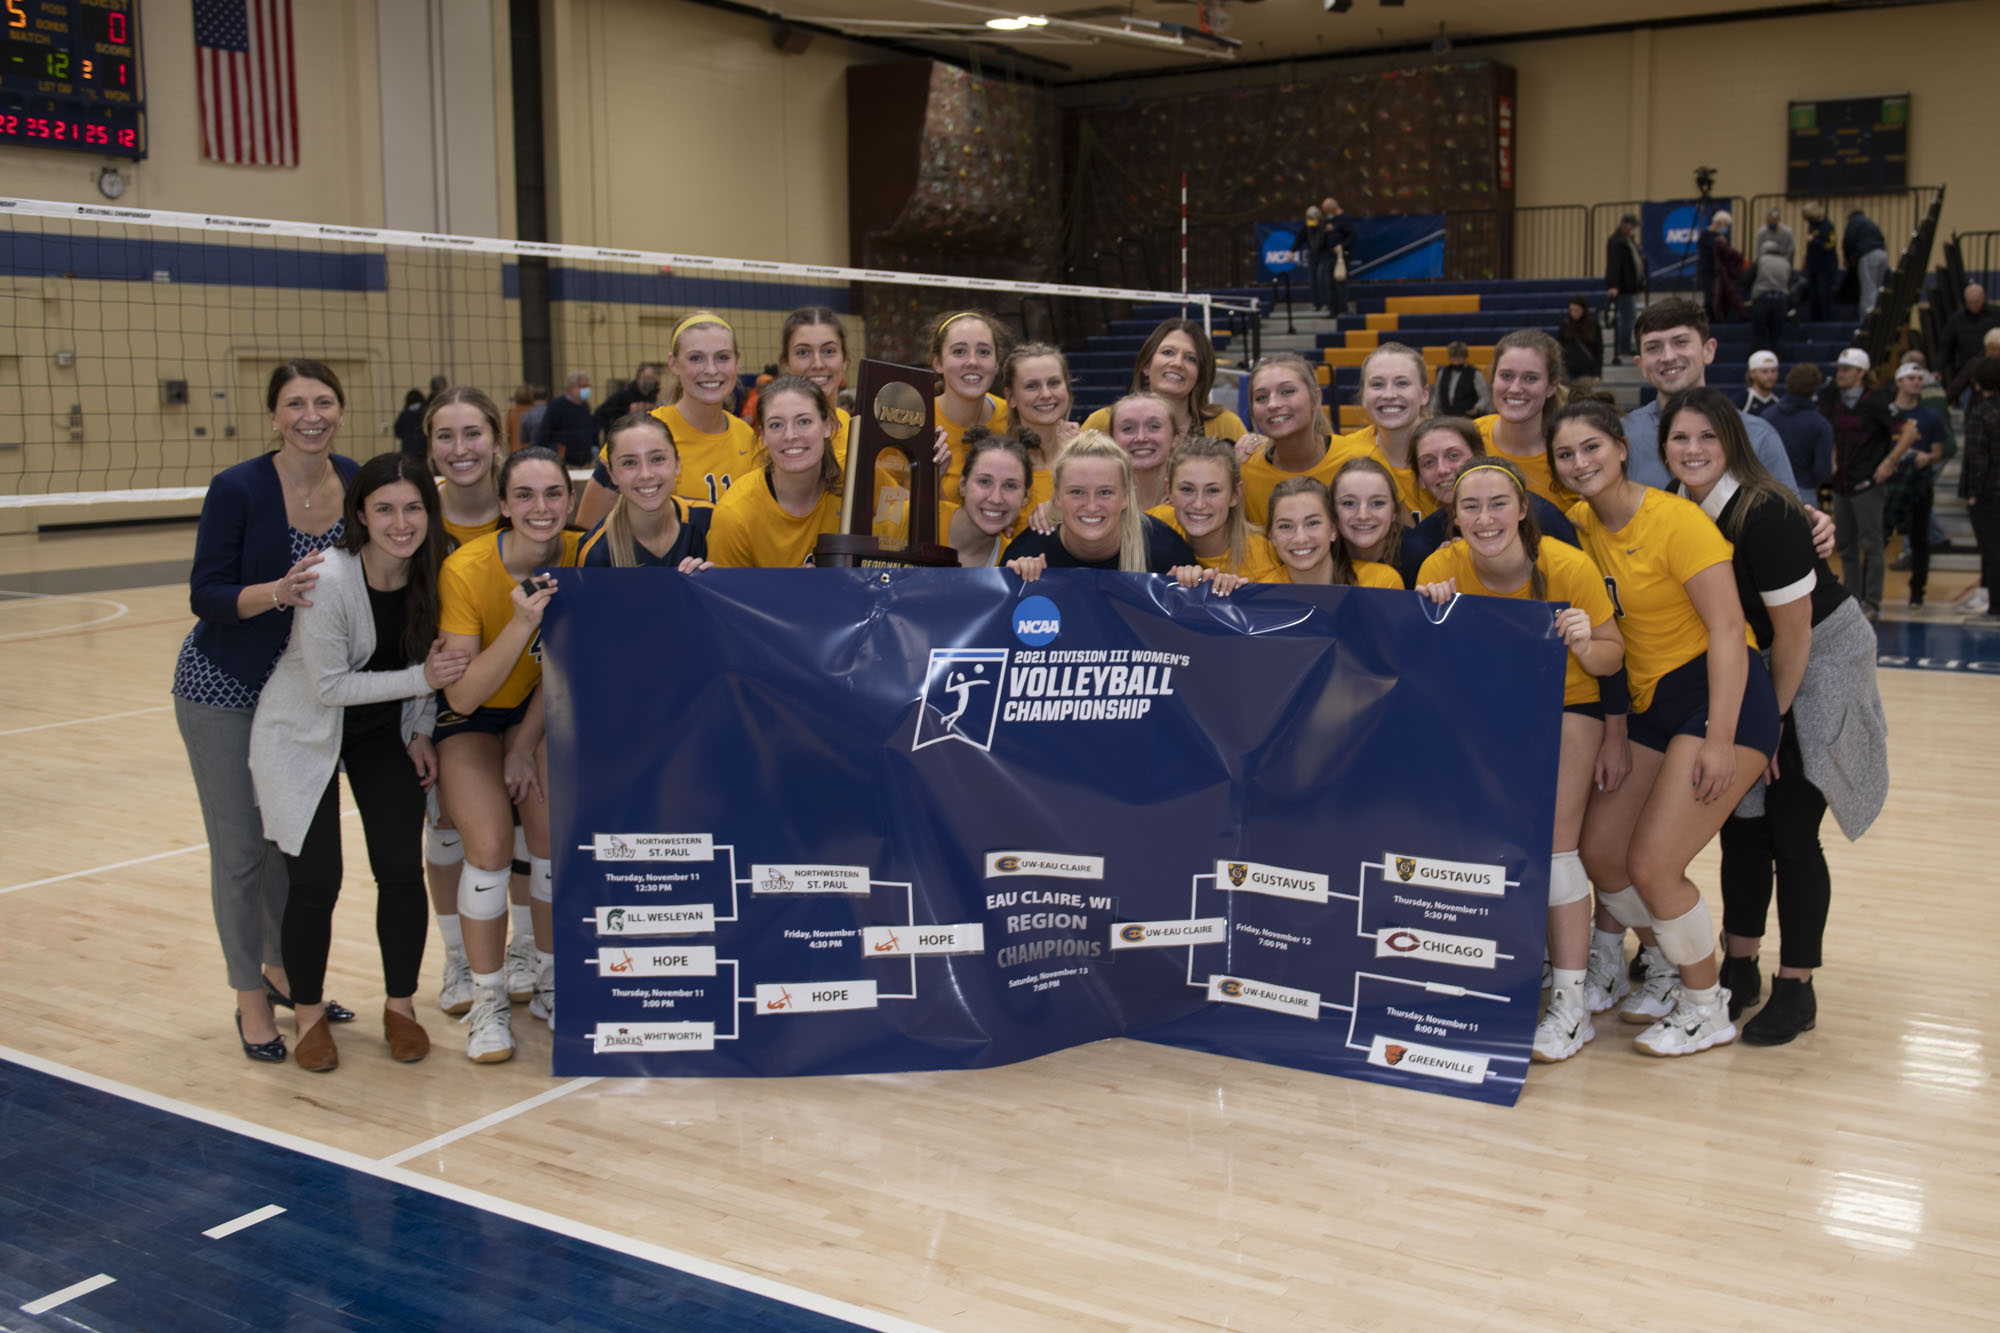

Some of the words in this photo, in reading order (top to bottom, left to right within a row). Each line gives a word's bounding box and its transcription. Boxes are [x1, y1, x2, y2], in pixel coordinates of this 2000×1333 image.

[108, 11, 127, 44] 0
[46, 53, 70, 79] 12
[119, 63, 126, 85] 1
[53, 120, 79, 141] 21
[85, 123, 109, 145] 25
[117, 128, 136, 148] 12
[880, 407, 924, 427] NCAA
[1017, 620, 1060, 634] NCAA
[1014, 651, 1046, 664] 2021
[1048, 650, 1107, 663] DIVISION
[1109, 650, 1129, 663] III
[1131, 650, 1190, 667] WOMEN'S
[1009, 666, 1174, 698] VOLLEYBALL
[1003, 699, 1151, 722] CHAMPIONSHIP
[649, 848, 664, 857] ST.
[665, 848, 691, 857] PAUL
[1021, 860, 1059, 870] UW-EAU
[1060, 863, 1092, 872] CLAIRE
[605, 873, 645, 883] Thursday,
[646, 873, 689, 881] November
[794, 870, 859, 878] NORTHWESTERN
[1420, 867, 1491, 885] GUSTAVUS
[635, 884, 658, 892] 12:30
[807, 881, 822, 889] ST.
[823, 881, 849, 889] PAUL
[1252, 872, 1316, 892] GUSTAVUS
[986, 892, 1018, 910] EAU
[1020, 891, 1086, 909] CLAIRE,
[1089, 896, 1112, 910] WI
[1394, 895, 1433, 909] Thursday,
[1434, 901, 1477, 915] November
[1479, 908, 1489, 916] 11
[627, 914, 646, 923] ILL.
[648, 912, 703, 922] WESLEYAN
[1007, 913, 1088, 934] REGION
[1424, 911, 1442, 920] 5:30
[1443, 914, 1457, 922] PM
[784, 929, 812, 940] Friday,
[812, 929, 856, 938] November
[1145, 928, 1182, 937] UW-EAU
[1183, 925, 1213, 935] CLAIRE
[1236, 923, 1262, 936] Friday,
[1262, 928, 1300, 943] November
[1302, 937, 1312, 945] 12
[809, 940, 828, 949] 4:30
[829, 939, 843, 948] PM
[919, 934, 955, 946] HOPE
[1258, 937, 1275, 948] 7:00
[1275, 941, 1288, 950] PM
[997, 939, 1102, 969] CHAMPIONS
[1422, 939, 1484, 958] CHICAGO
[653, 955, 689, 967] HOPE
[1008, 975, 1040, 989] Saturday,
[1039, 968, 1077, 980] November
[1048, 980, 1061, 989] PM
[612, 988, 650, 998] Thursday,
[651, 988, 693, 997] November
[694, 988, 704, 997] 11
[812, 989, 849, 1002] HOPE
[1243, 986, 1279, 1001] UW-EAU
[1279, 994, 1310, 1007] CLAIRE
[642, 1000, 660, 1008] 3:00
[661, 1000, 675, 1008] PM
[1386, 1006, 1425, 1022] Thursday,
[1425, 1014, 1468, 1030] November
[1469, 1023, 1479, 1032] 11
[644, 1031, 702, 1040] WHITWORTH
[1414, 1023, 1433, 1034] 8:00
[1433, 1028, 1447, 1037] PM
[1408, 1053, 1475, 1074] GREENVILLE
